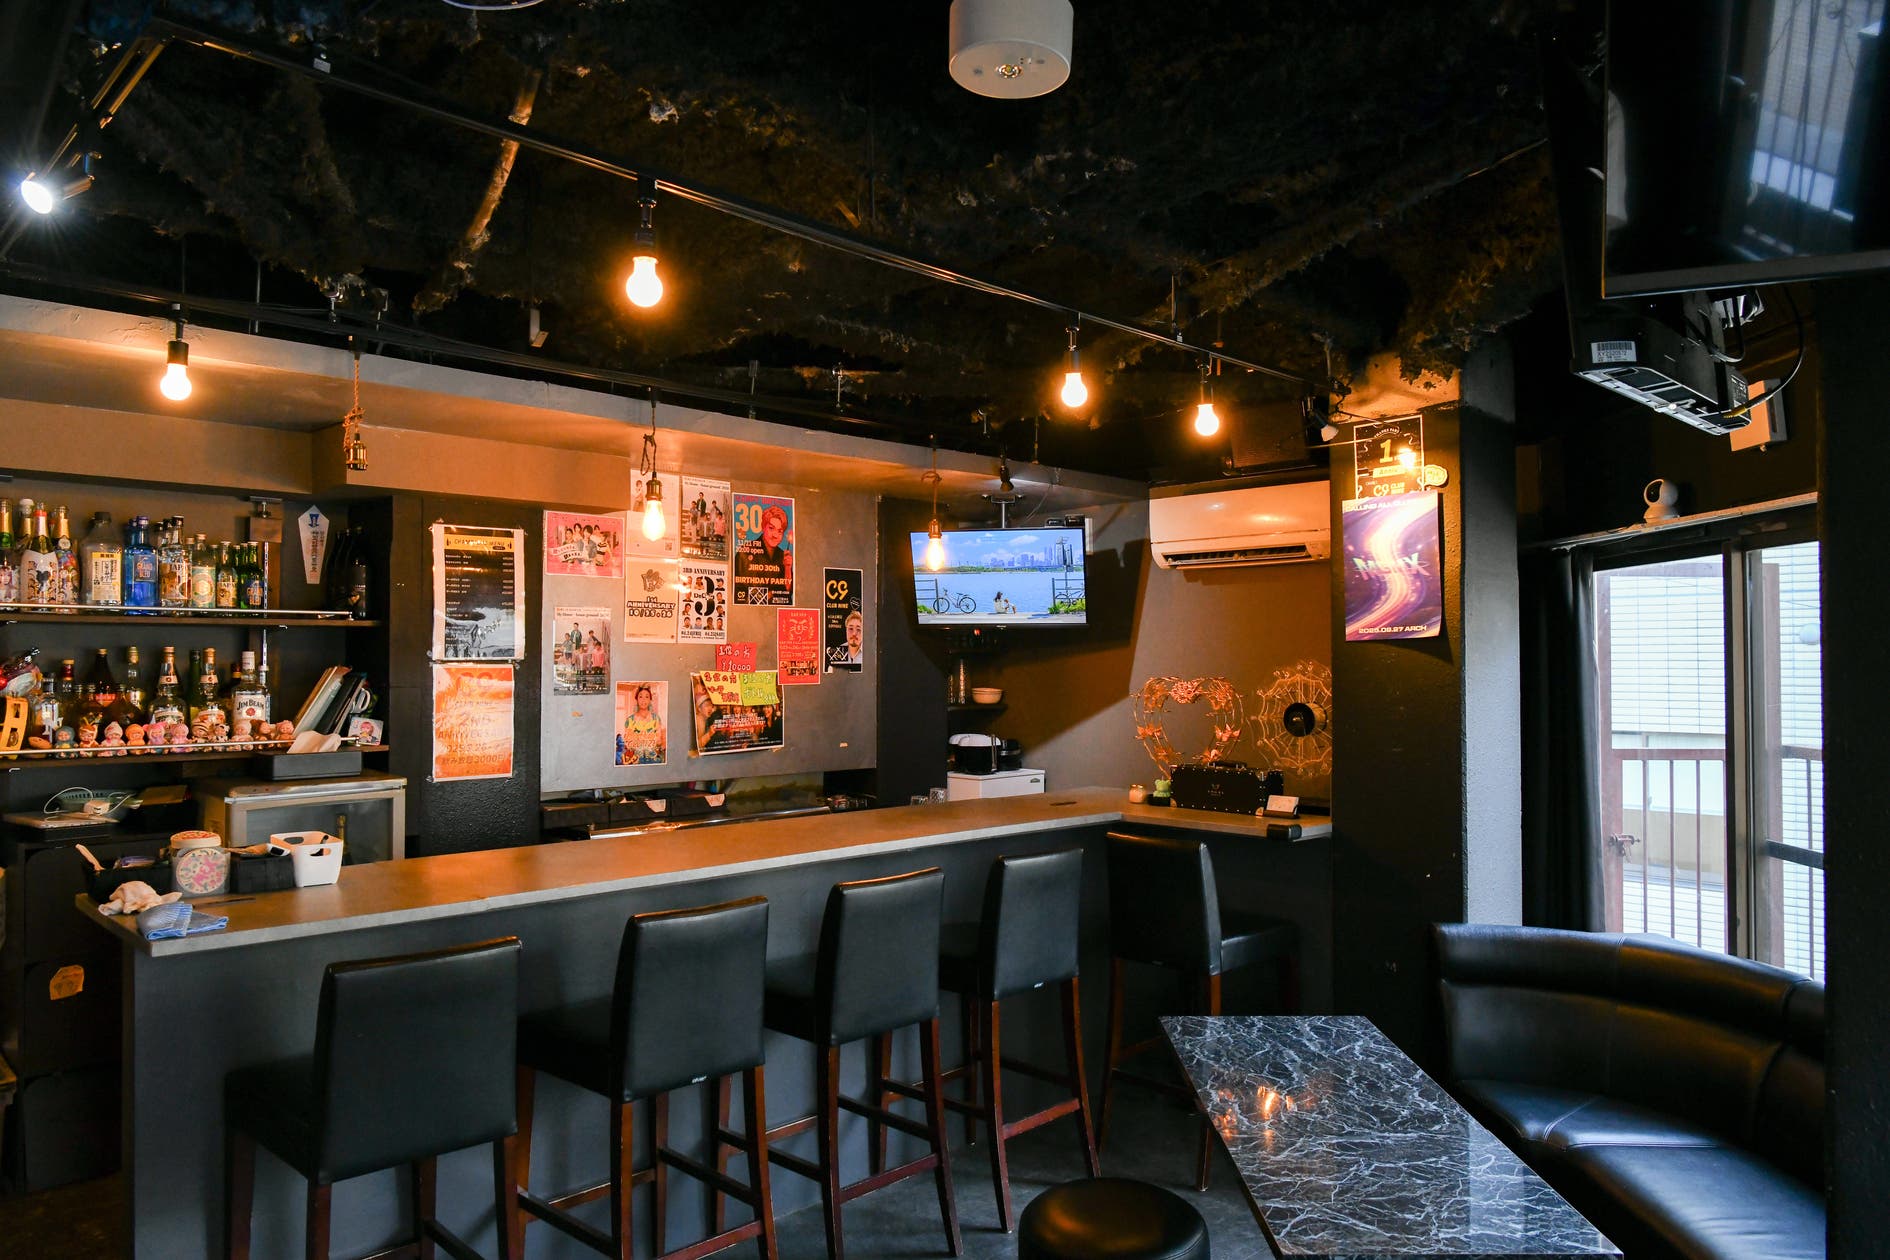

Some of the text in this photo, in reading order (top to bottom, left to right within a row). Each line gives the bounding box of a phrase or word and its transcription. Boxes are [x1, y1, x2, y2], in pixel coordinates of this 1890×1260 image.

[735, 503, 763, 534] 30
[826, 580, 848, 600] C9
[627, 601, 675, 610] ANNIVERSARY
[237, 699, 264, 710] JIM BEAM
